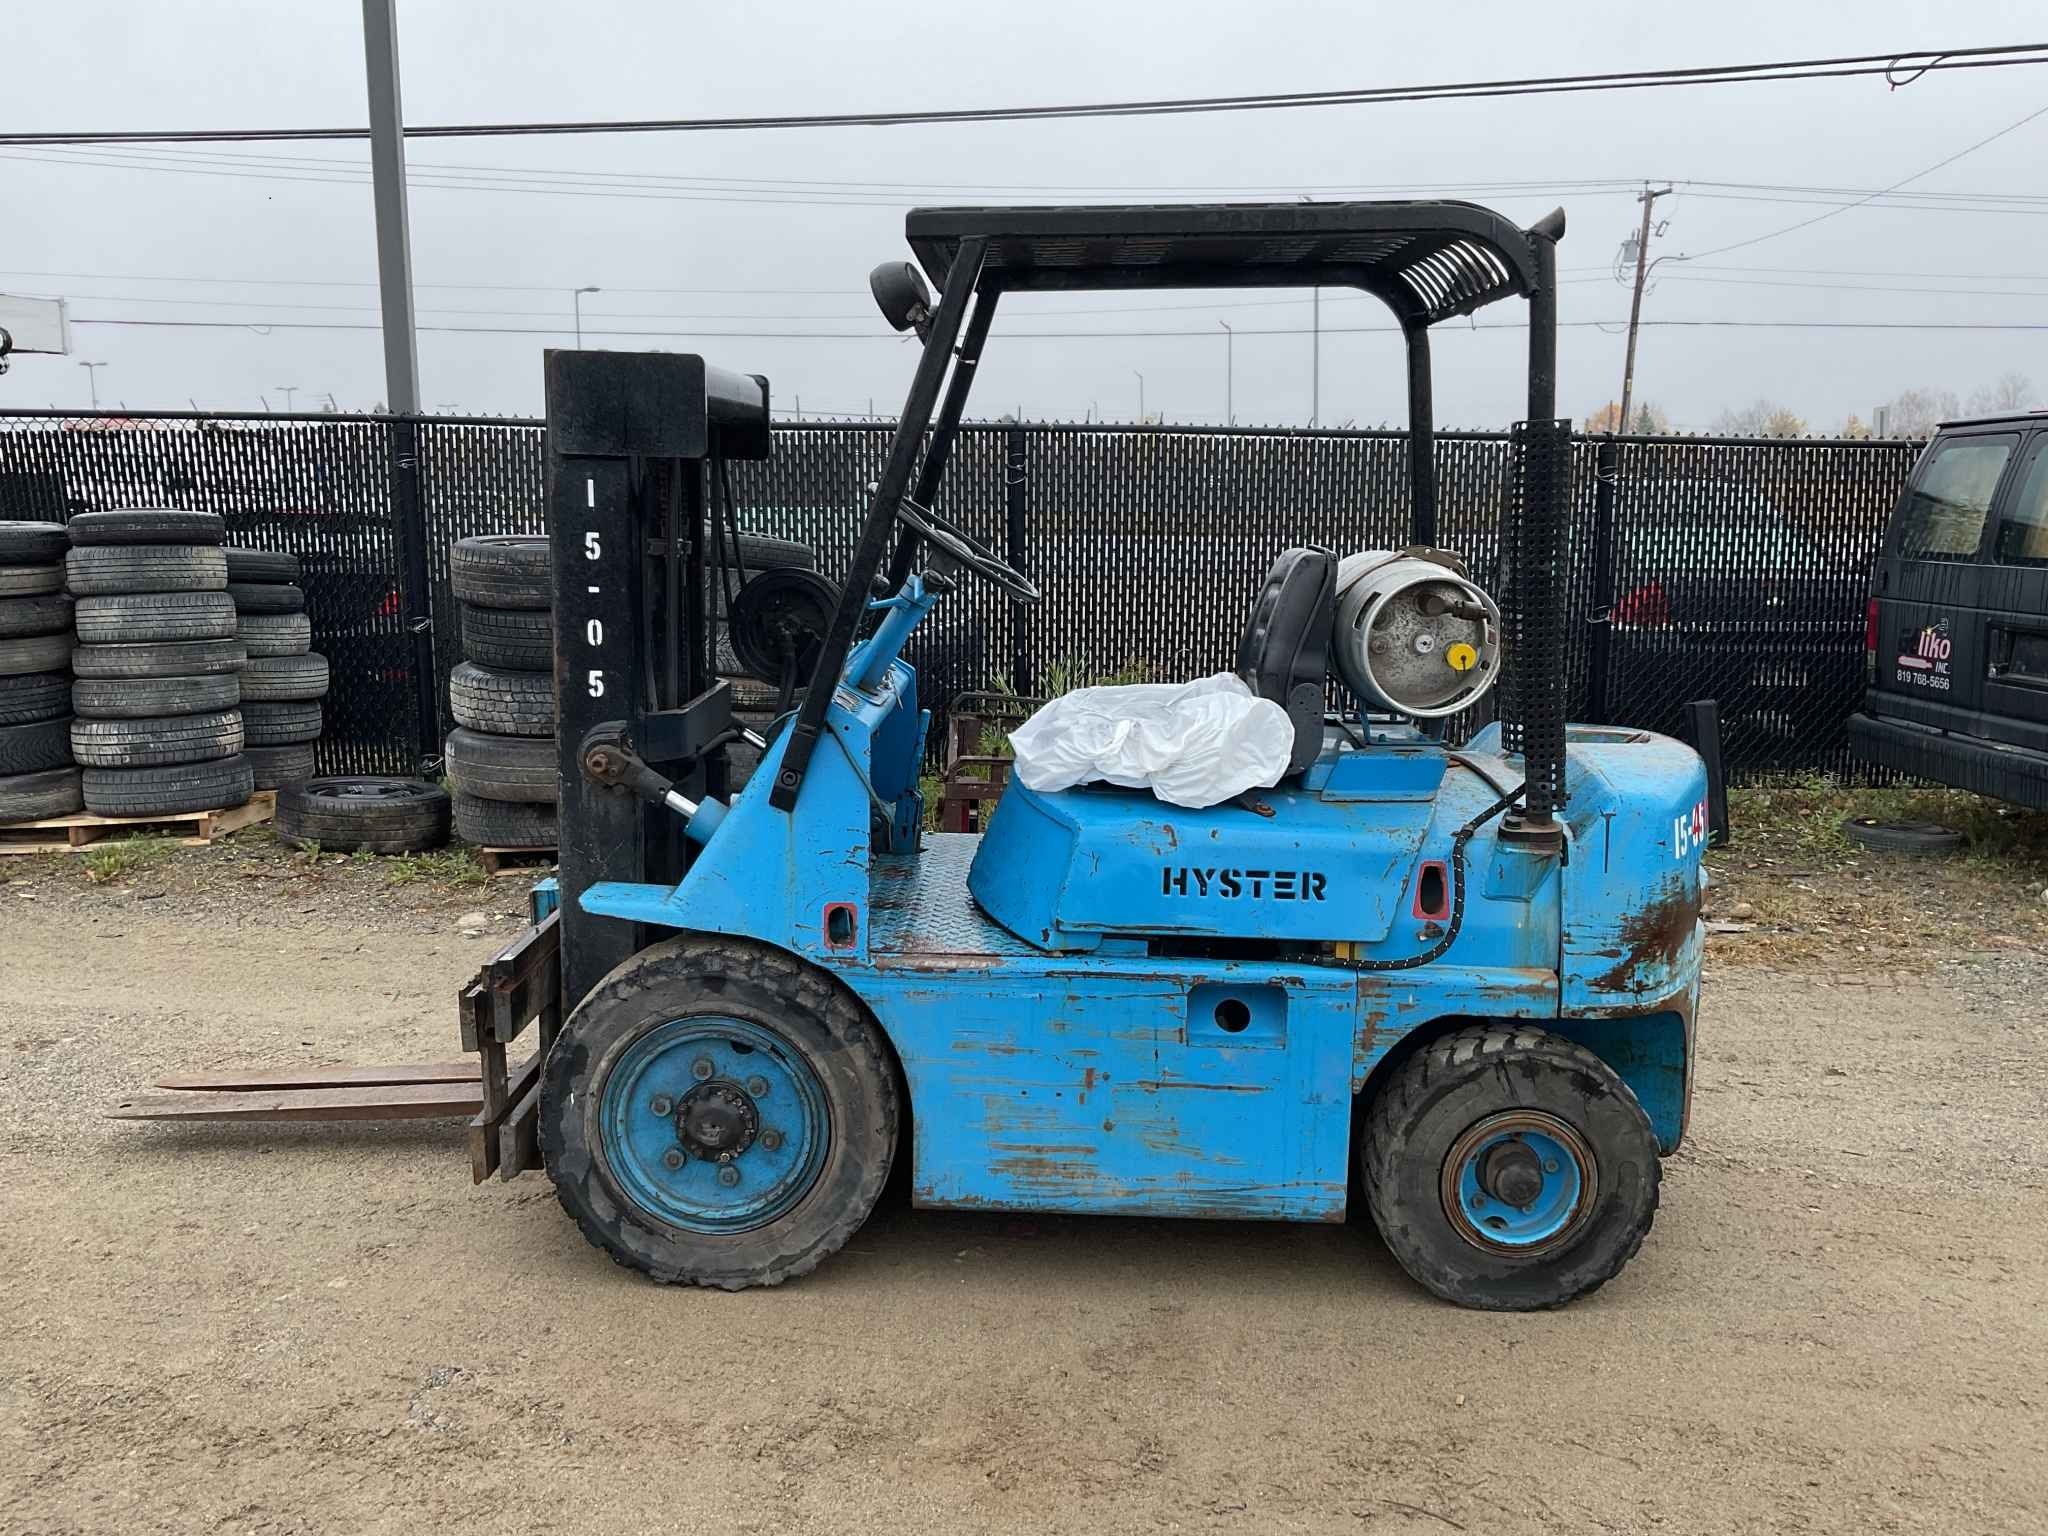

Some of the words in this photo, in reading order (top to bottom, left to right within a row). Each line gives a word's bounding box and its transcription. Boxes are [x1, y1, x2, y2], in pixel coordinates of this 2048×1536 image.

[1897, 669, 1911, 682] 819
[1912, 672, 1950, 690] 768-5656
[1162, 867, 1327, 901] HYSTER
